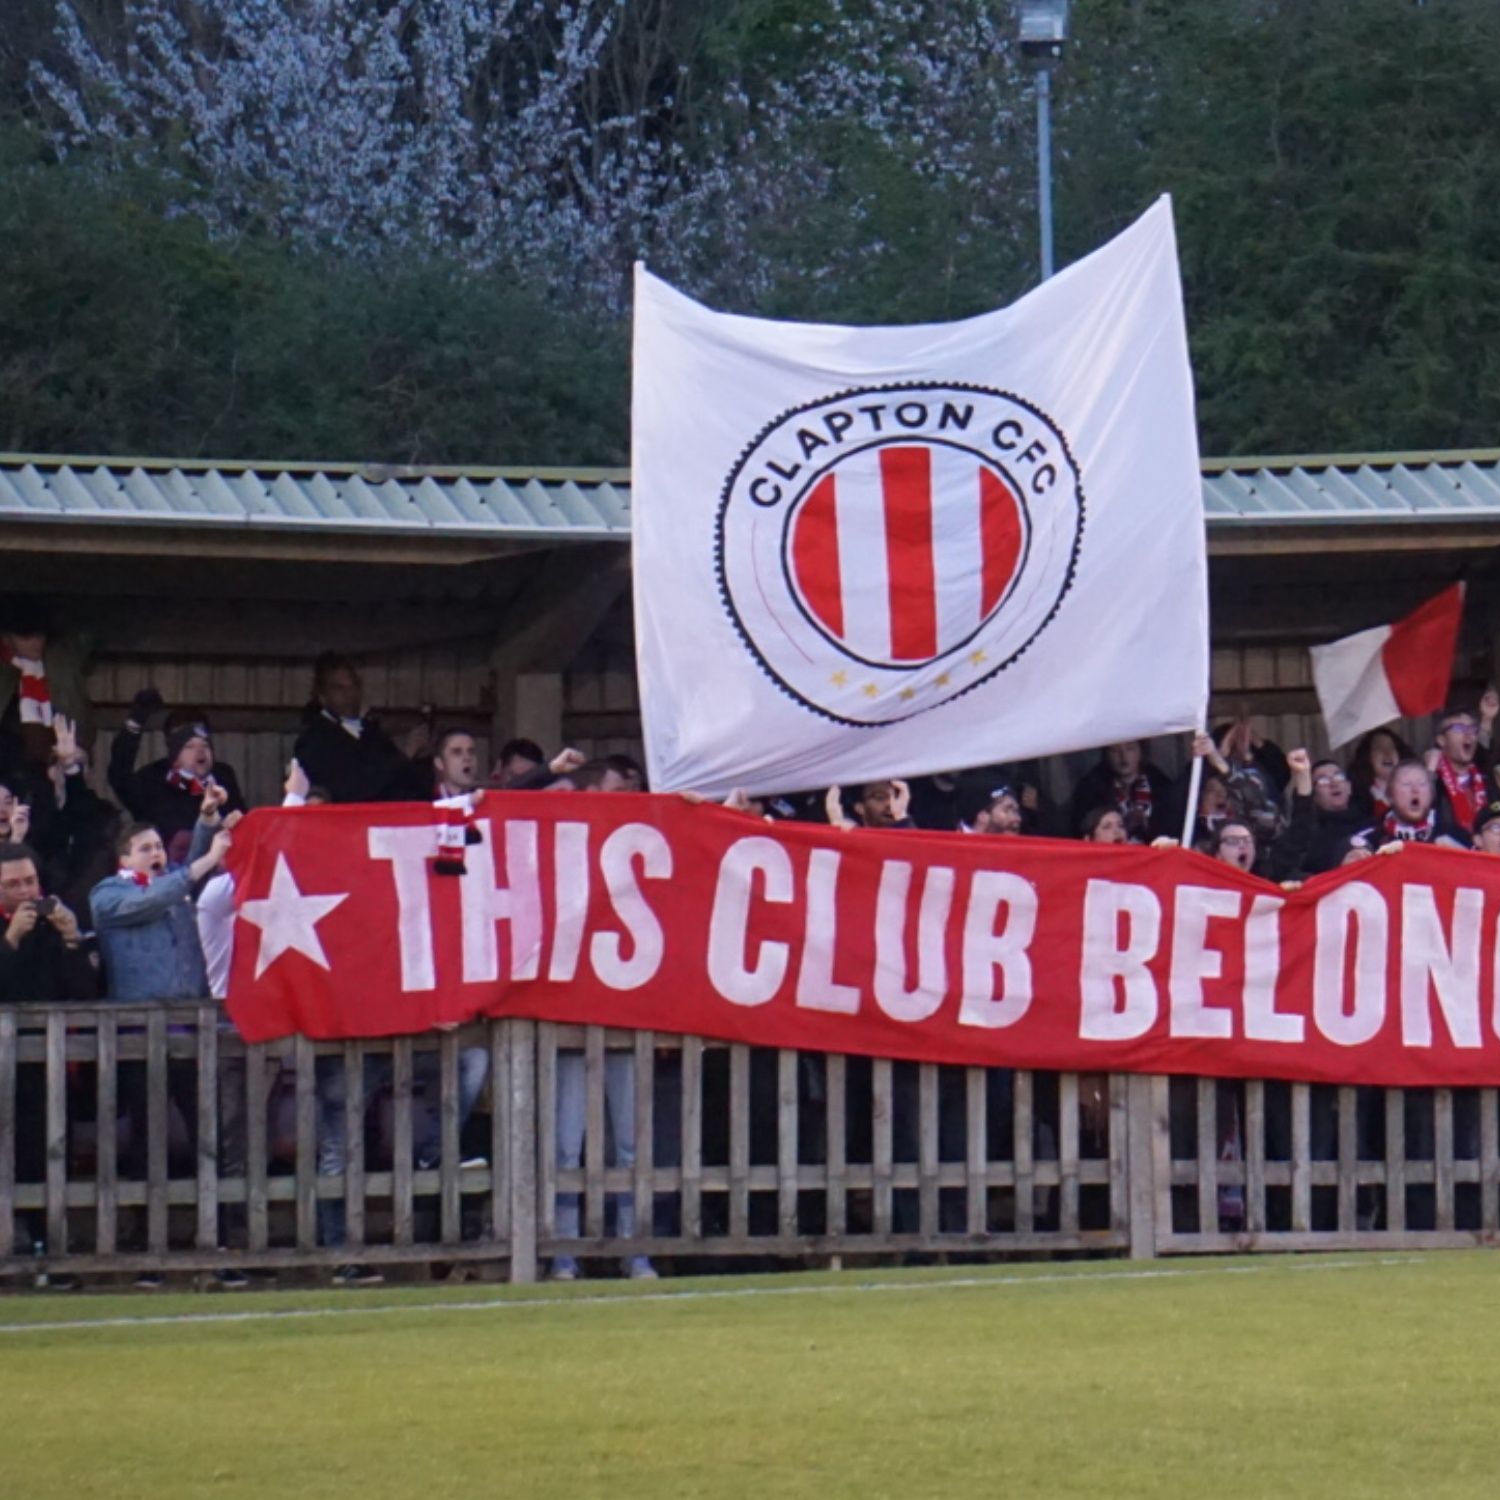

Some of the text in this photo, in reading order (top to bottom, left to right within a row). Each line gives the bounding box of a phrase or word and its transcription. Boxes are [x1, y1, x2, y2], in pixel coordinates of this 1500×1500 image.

[749, 402, 1056, 508] CLAPTON CFC
[368, 819, 672, 992] THIS
[707, 836, 1038, 1028] CLUB
